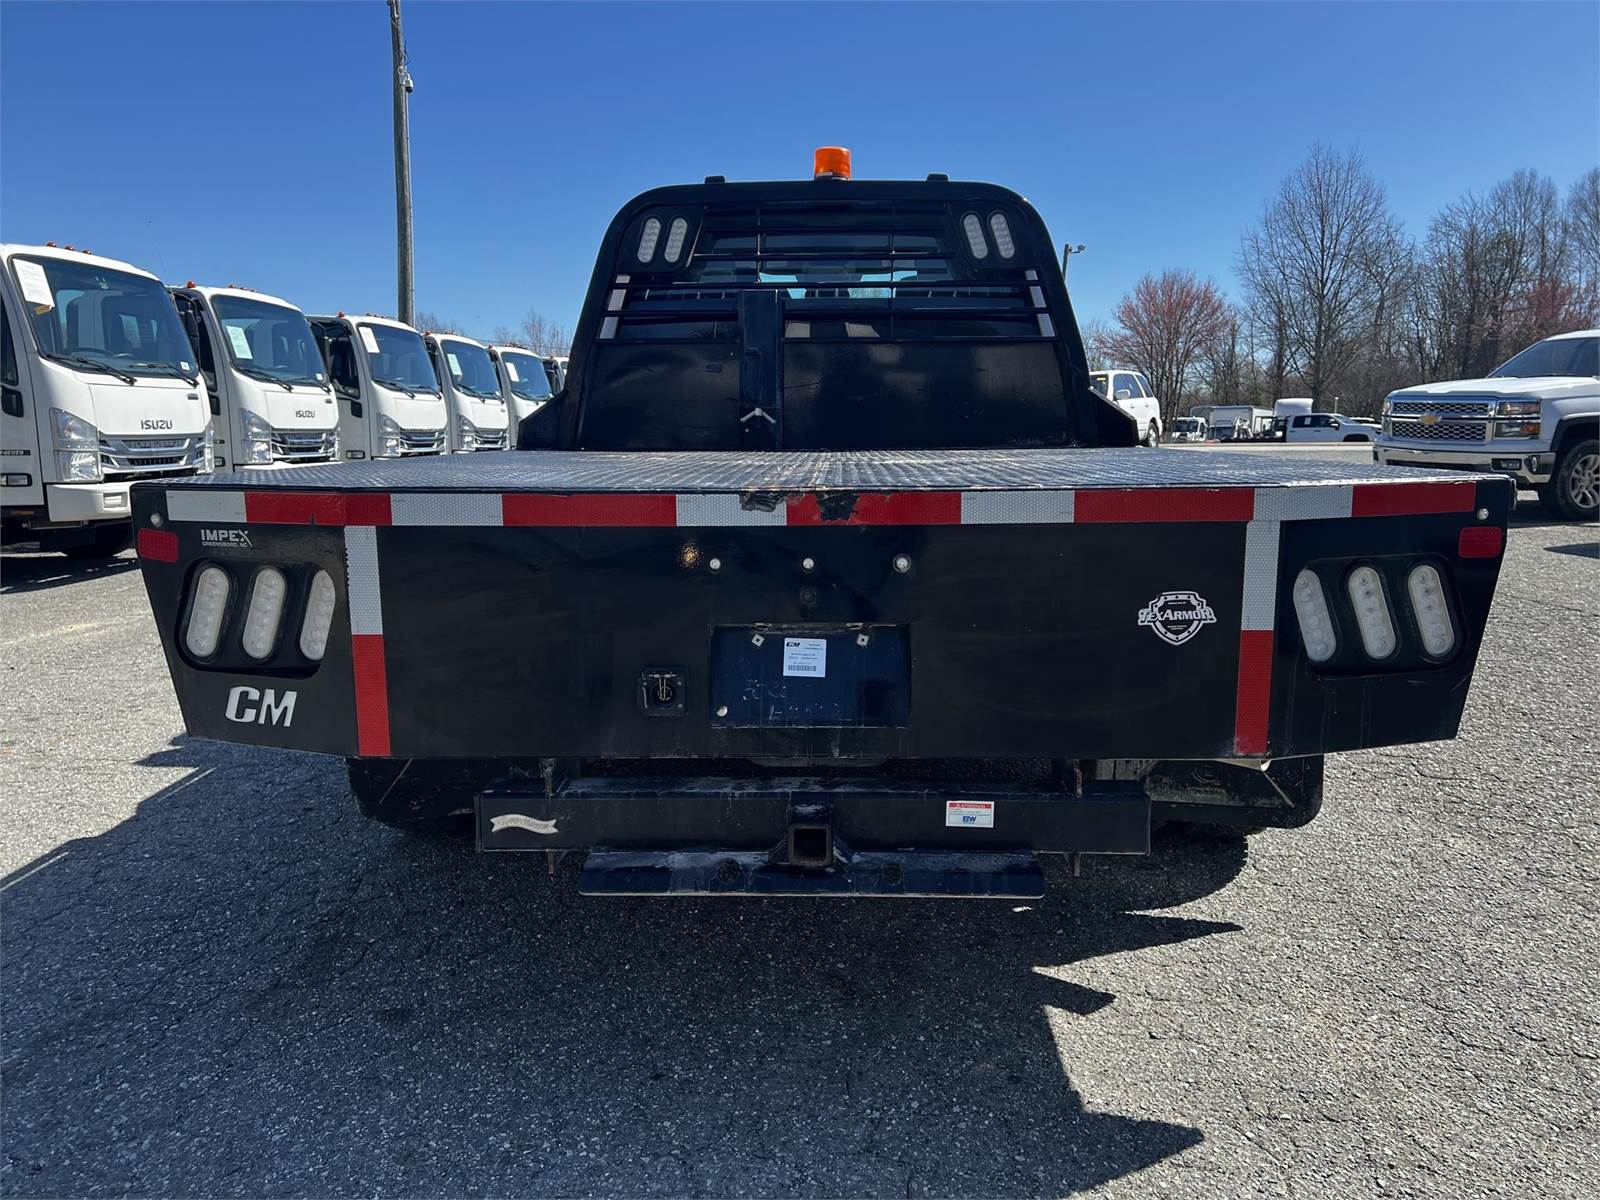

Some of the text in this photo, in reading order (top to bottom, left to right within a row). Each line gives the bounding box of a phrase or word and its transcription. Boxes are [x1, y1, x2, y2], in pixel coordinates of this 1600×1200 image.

[295, 410, 316, 418] ISUZU
[140, 419, 173, 430] ISUZU
[200, 529, 252, 545] IMPEX
[225, 686, 298, 727] CM
